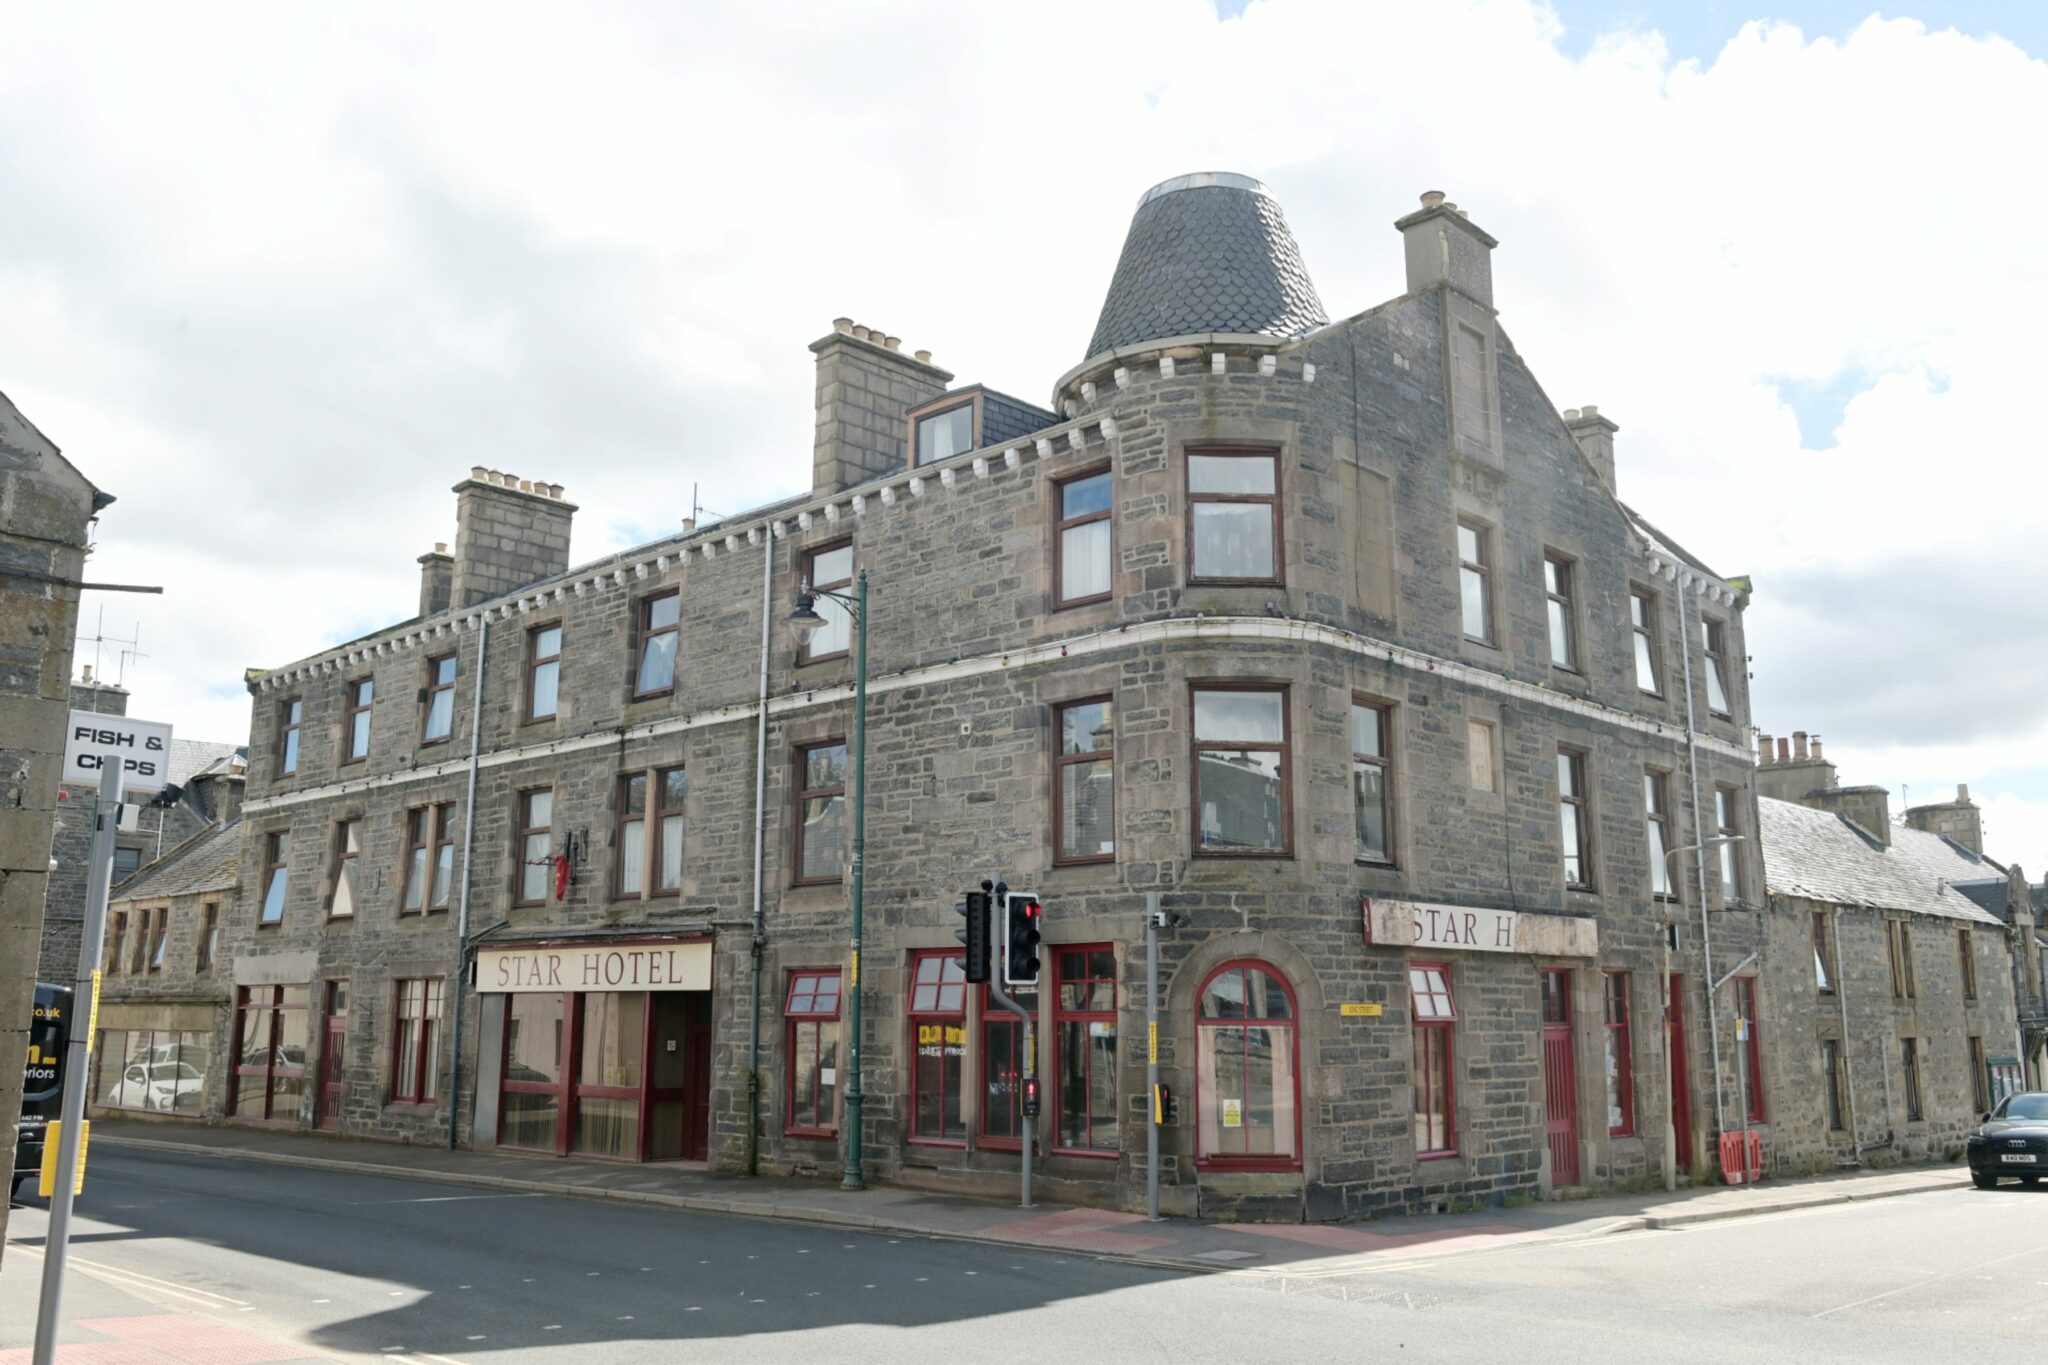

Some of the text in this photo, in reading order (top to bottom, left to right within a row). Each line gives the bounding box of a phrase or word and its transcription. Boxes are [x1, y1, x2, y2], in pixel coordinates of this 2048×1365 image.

[75, 727, 163, 751] FISH &
[77, 754, 156, 776] CPS
[498, 951, 683, 987] STAR HOTEL
